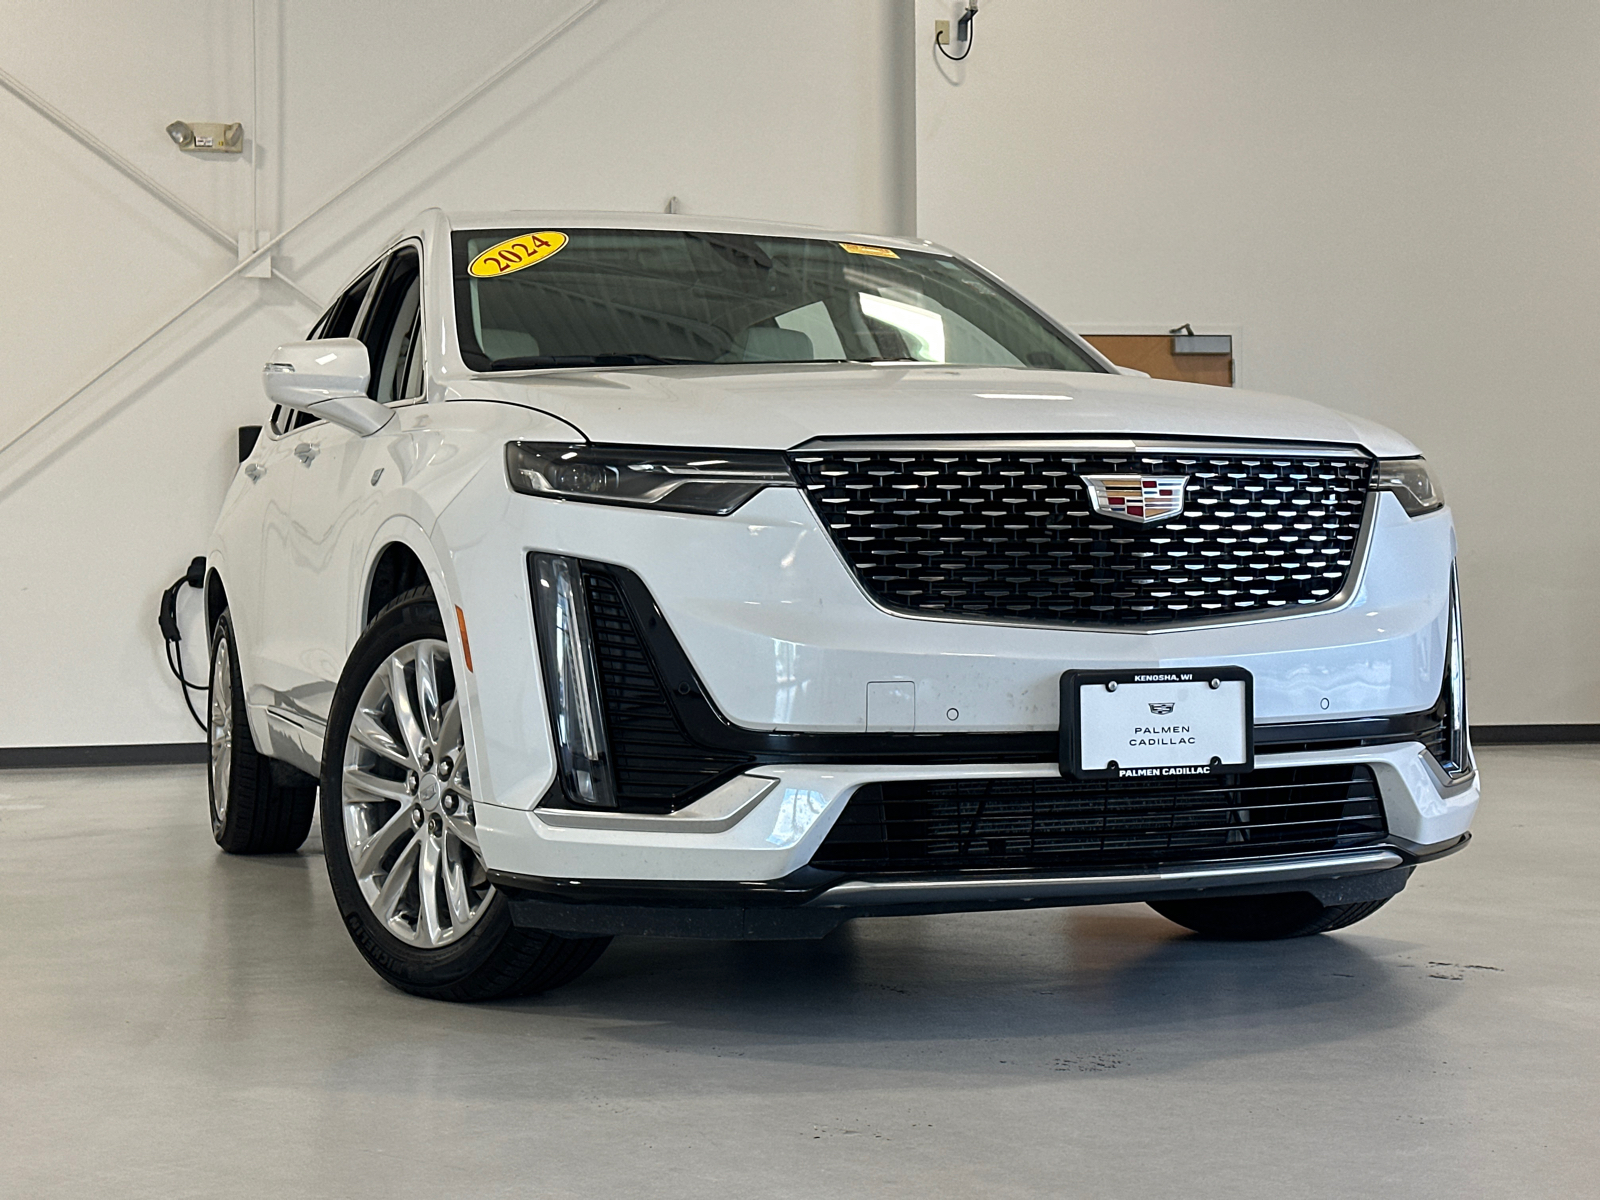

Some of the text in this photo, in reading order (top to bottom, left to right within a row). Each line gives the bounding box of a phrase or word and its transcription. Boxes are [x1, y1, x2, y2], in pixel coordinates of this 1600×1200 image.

[483, 235, 552, 272] 2024
[1134, 674, 1179, 682] KENOSHA,
[1134, 726, 1190, 734] PALMEN
[1128, 737, 1196, 746] CADILLAC
[1119, 766, 1211, 777] PALMEN CADILLAC
[347, 915, 404, 974] MICHELIN
